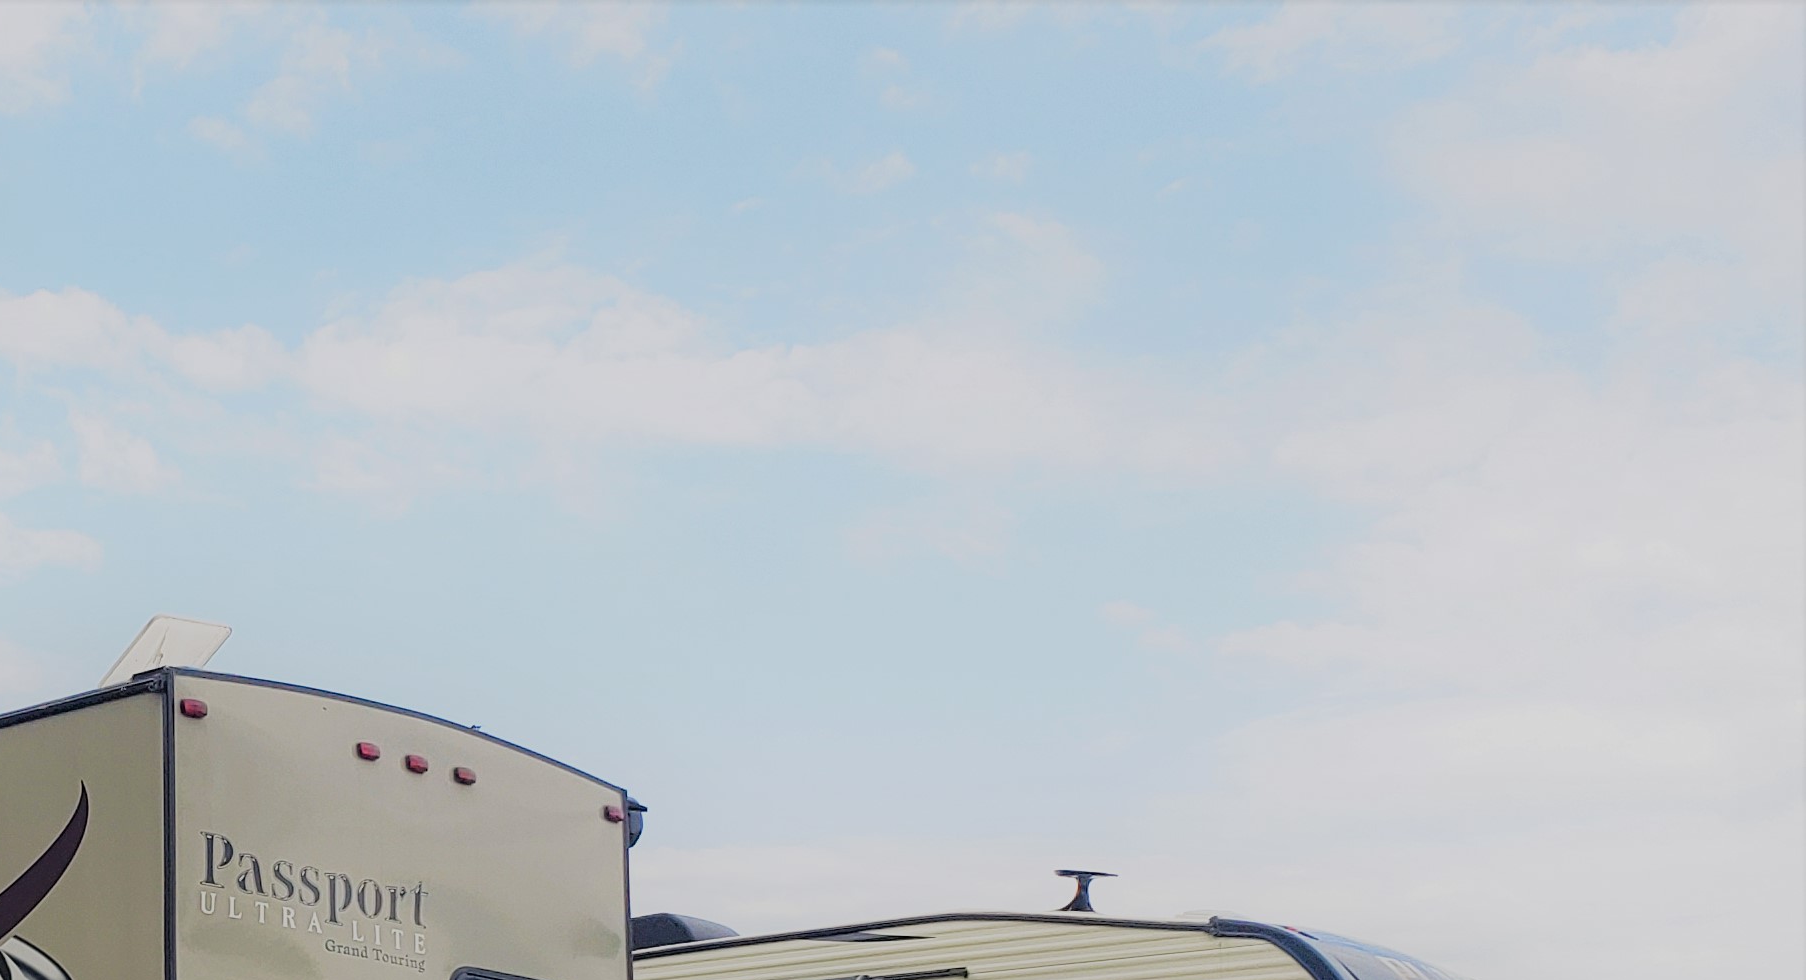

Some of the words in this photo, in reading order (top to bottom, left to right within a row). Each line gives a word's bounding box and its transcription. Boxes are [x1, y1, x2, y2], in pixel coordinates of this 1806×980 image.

[200, 831, 429, 929] Passport
[200, 890, 323, 934] ULTRA
[352, 919, 427, 955] LITE
[324, 939, 369, 959] Grand
[372, 948, 426, 973] Touring
